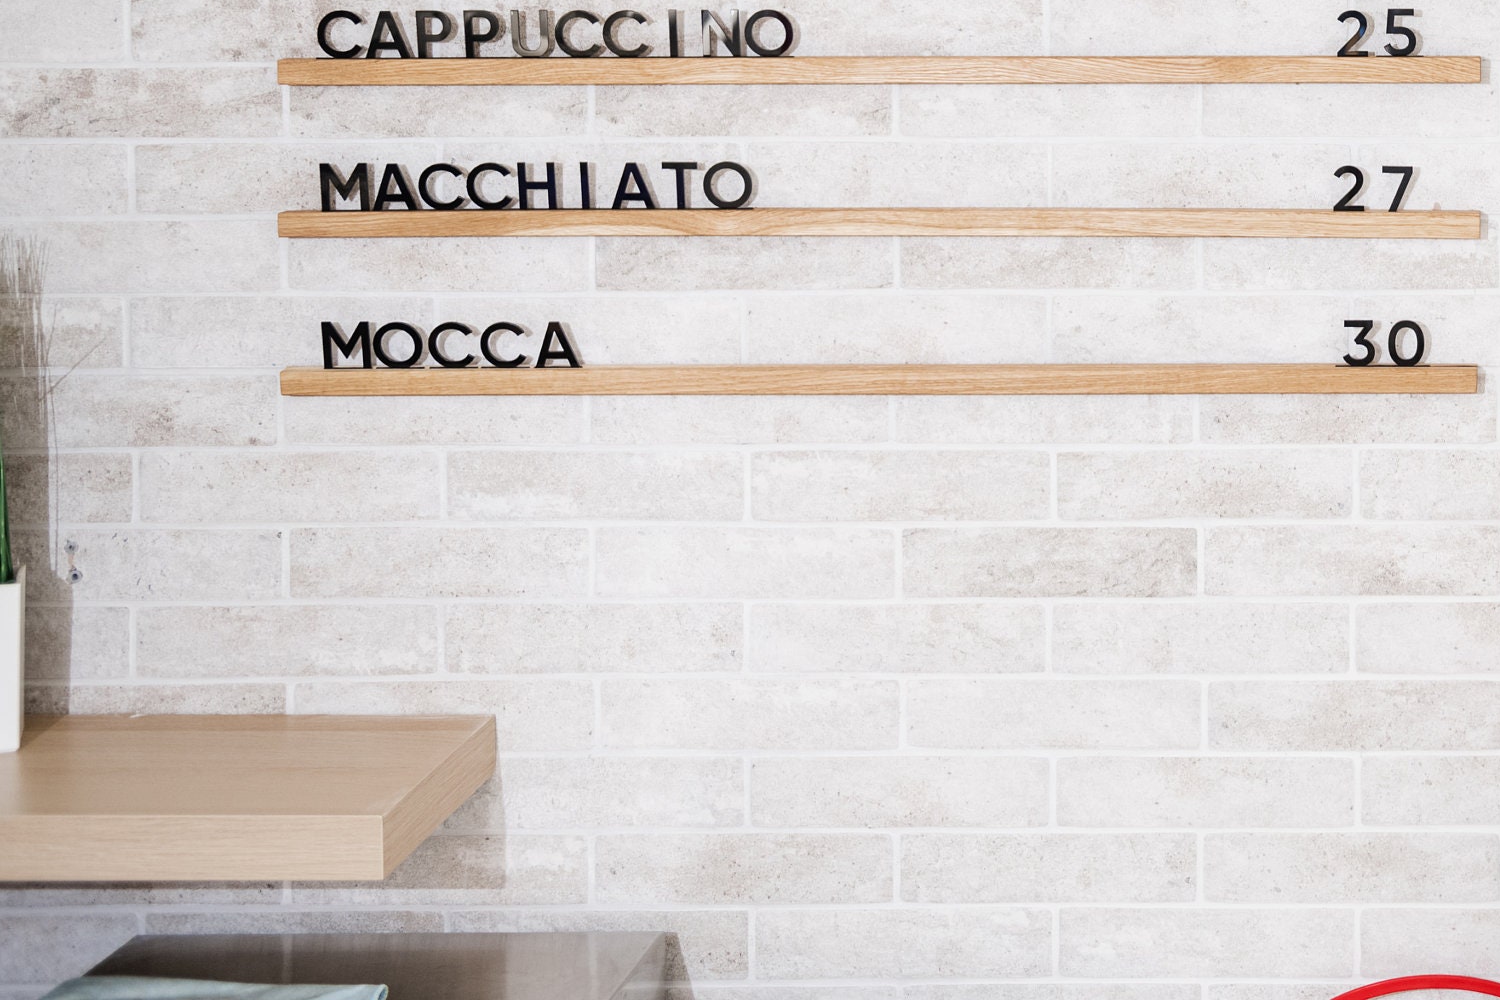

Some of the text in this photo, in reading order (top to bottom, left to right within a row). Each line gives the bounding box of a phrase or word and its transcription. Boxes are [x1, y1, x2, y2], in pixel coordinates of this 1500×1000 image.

[316, 8, 1418, 59] CAPPUCCINO 25
[319, 161, 1413, 212] MACCHIATO 27
[321, 319, 1425, 368] MOCCA 30
